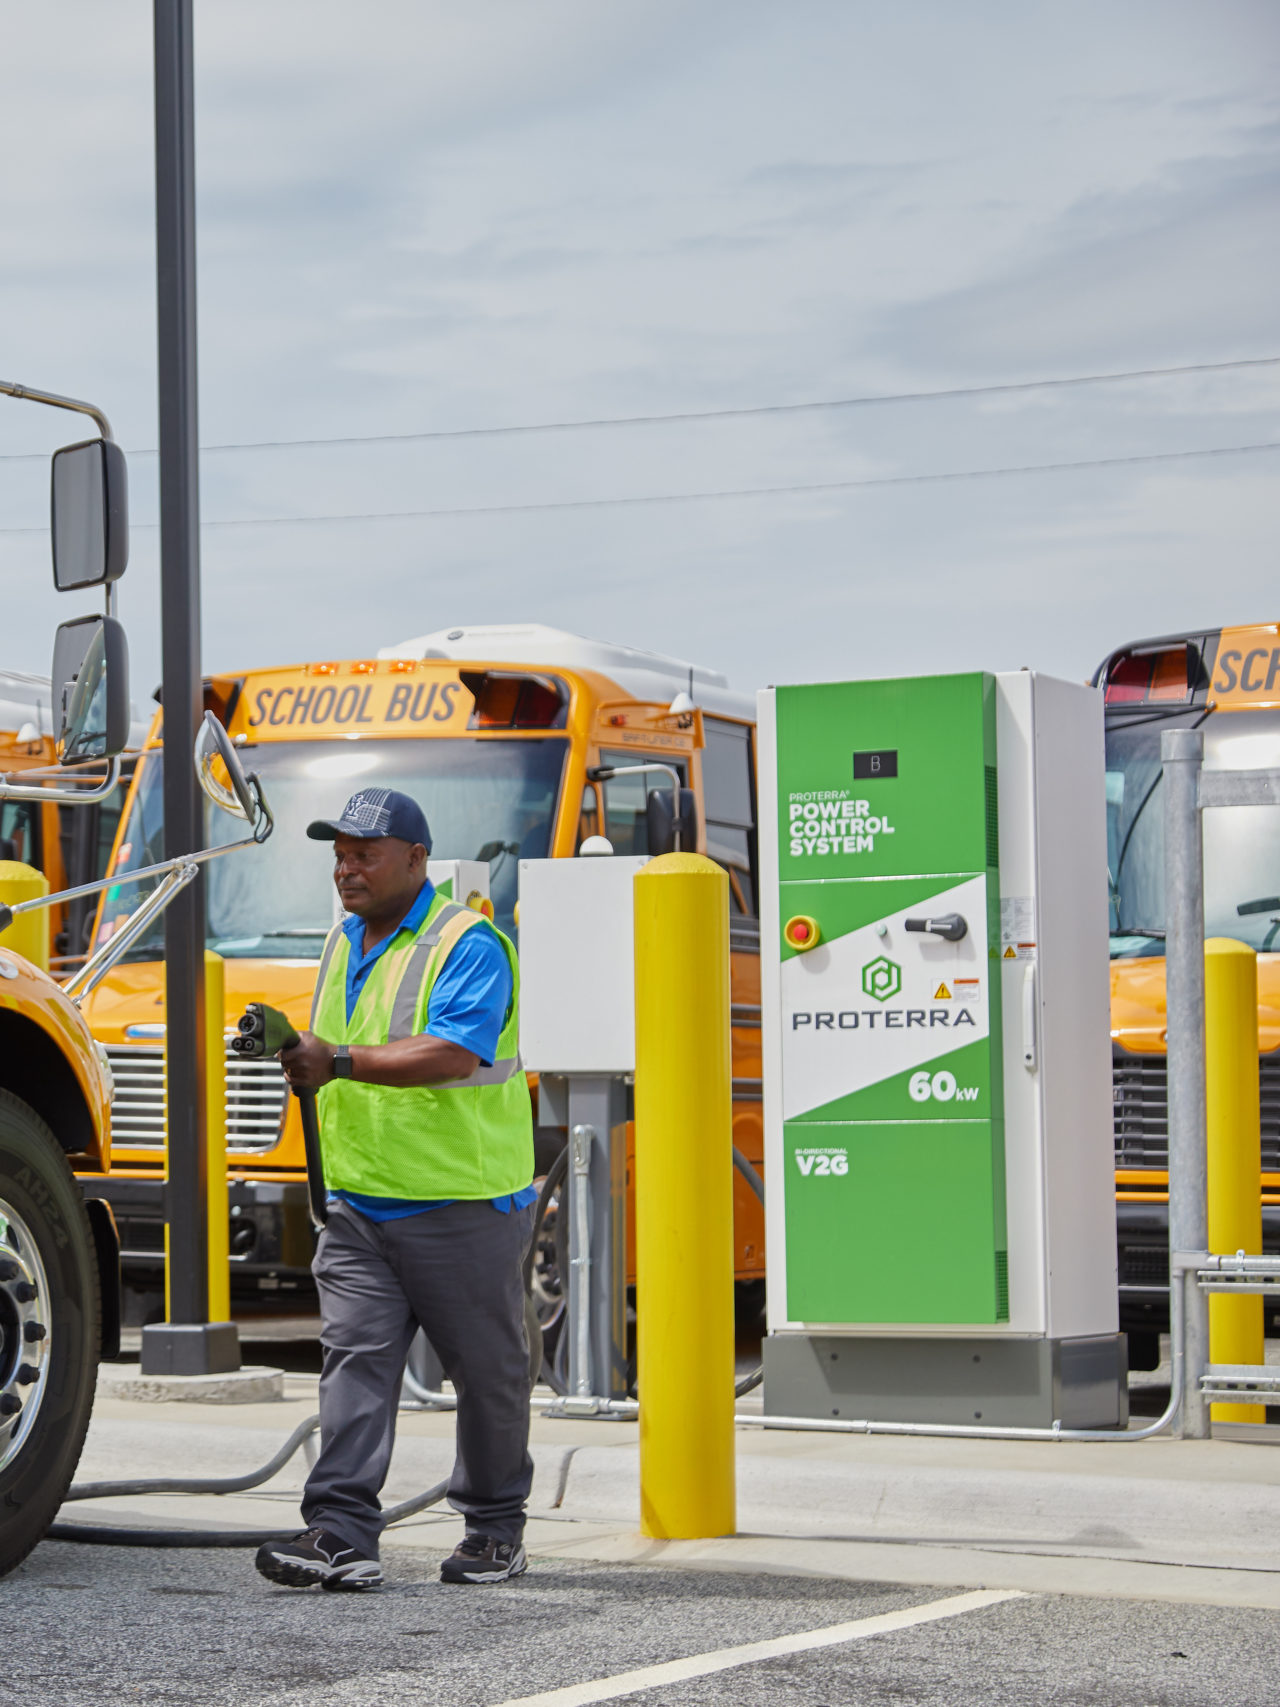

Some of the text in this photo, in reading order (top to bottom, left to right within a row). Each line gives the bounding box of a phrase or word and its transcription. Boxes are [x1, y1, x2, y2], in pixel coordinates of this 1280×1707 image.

[249, 682, 461, 726] SCHOOL BUS
[789, 800, 870, 820] POWER
[789, 816, 895, 838] CONTROL
[790, 835, 874, 857] SYSTEM
[792, 1008, 976, 1031] PROTERRA
[796, 1155, 849, 1176] V2G
